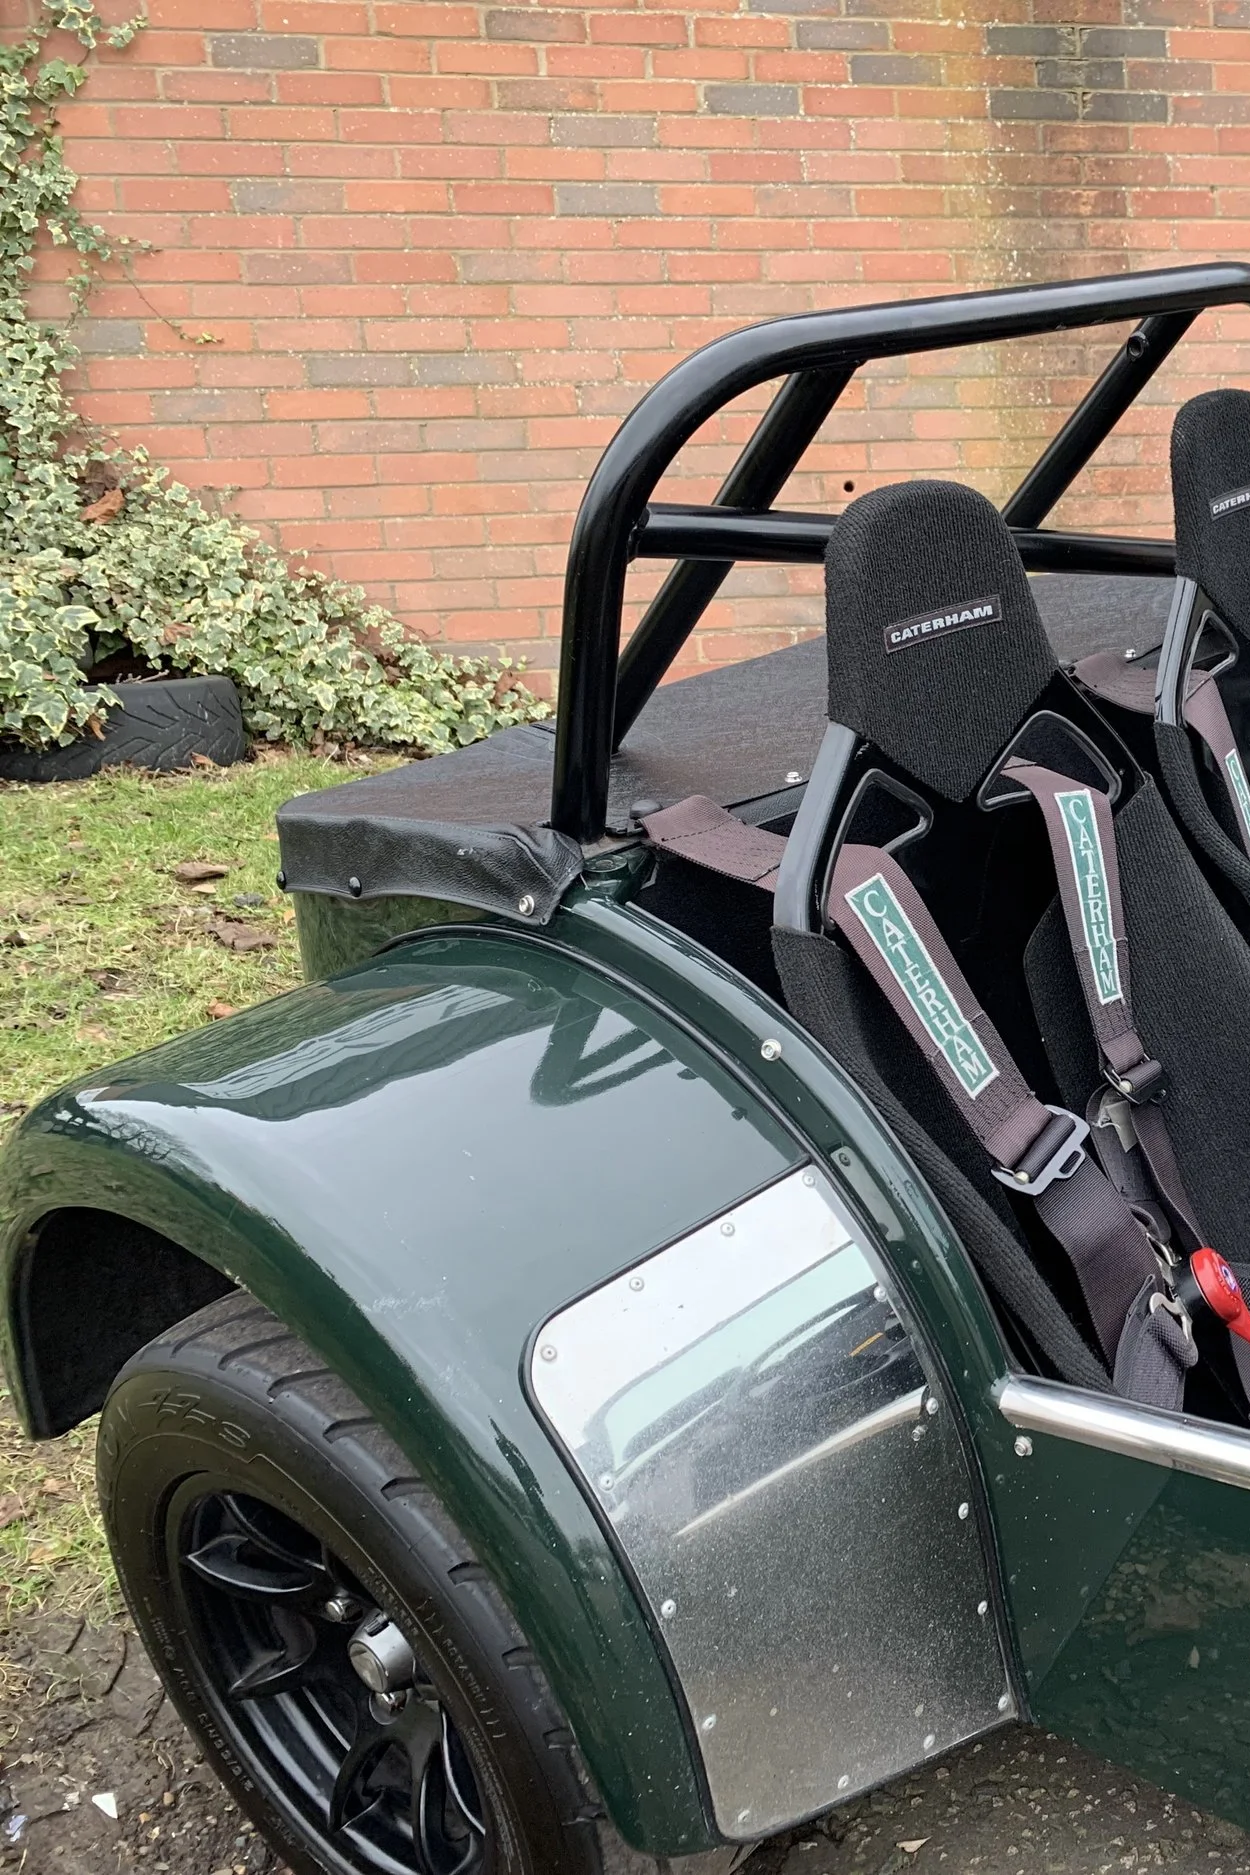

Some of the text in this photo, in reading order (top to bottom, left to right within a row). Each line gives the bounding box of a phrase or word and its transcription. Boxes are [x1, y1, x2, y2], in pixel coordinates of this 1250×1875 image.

[890, 604, 994, 646] CATERHAM
[864, 889, 992, 1086] CATERHAM
[1070, 798, 1118, 992] CATERHAM
